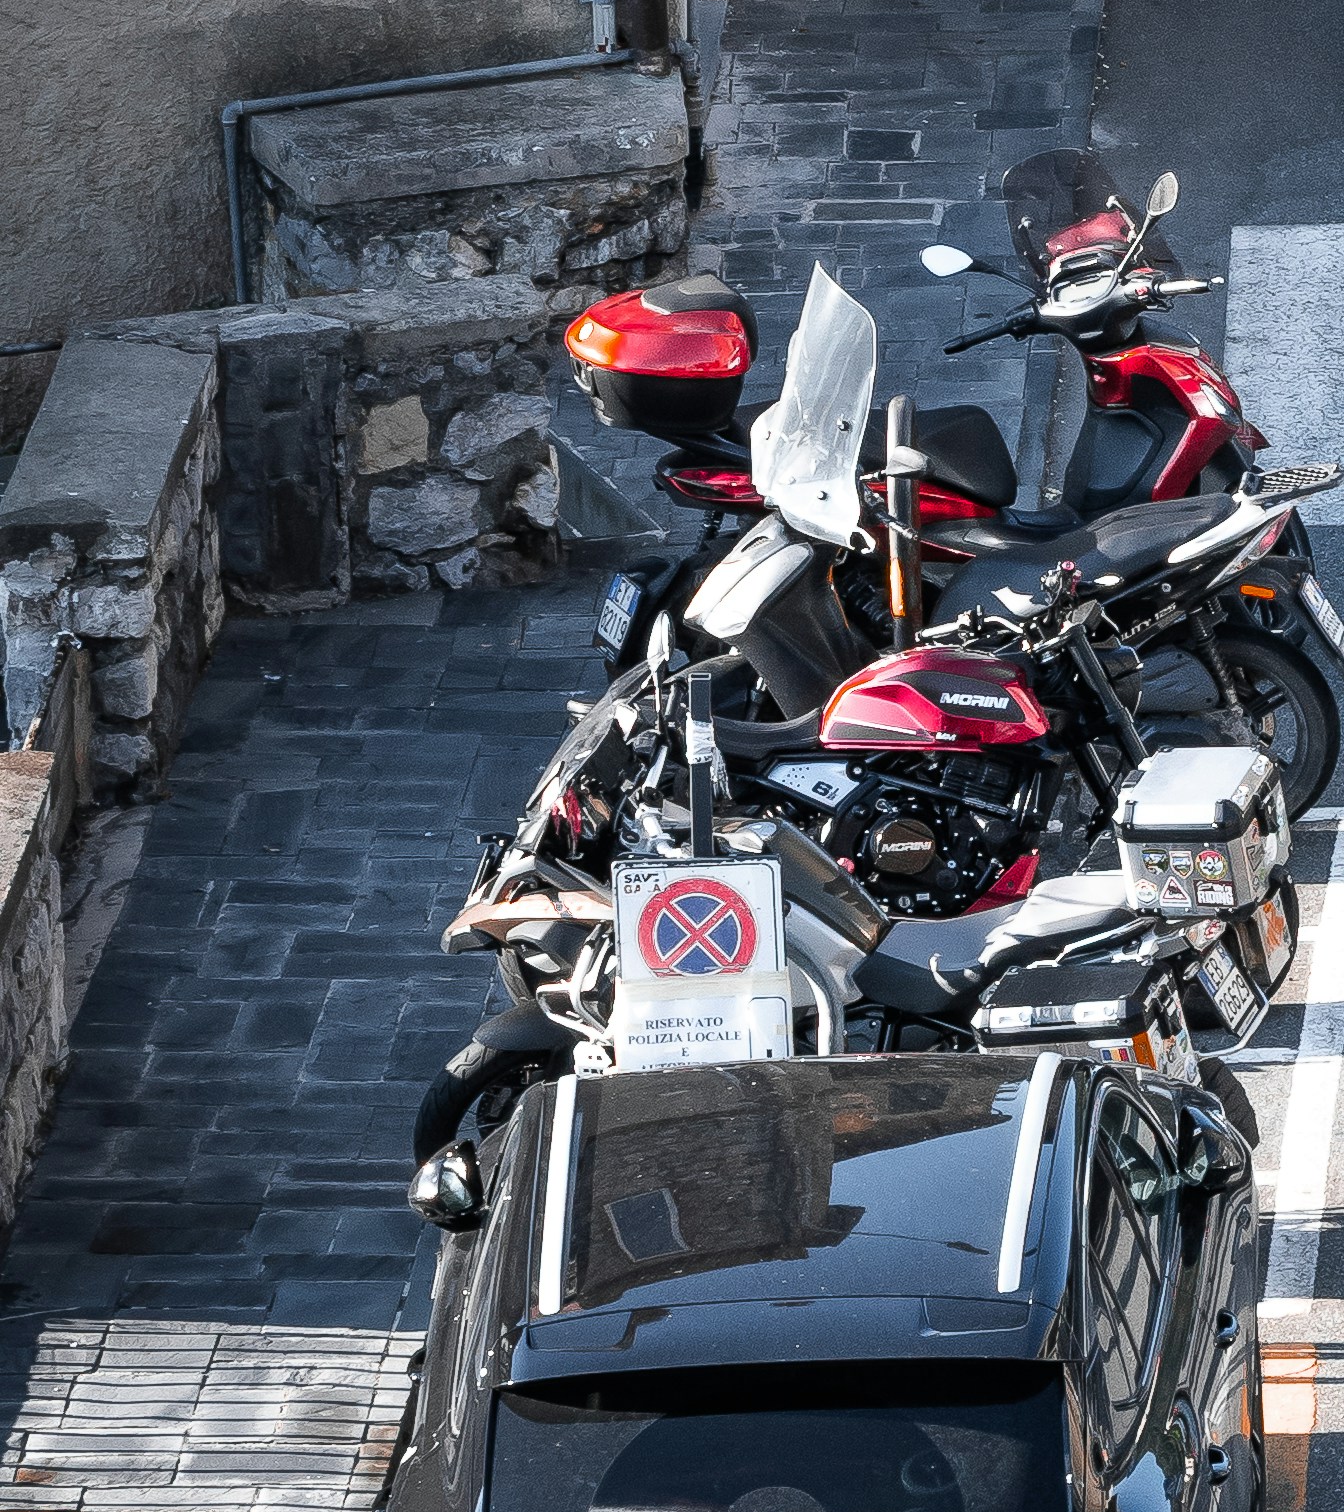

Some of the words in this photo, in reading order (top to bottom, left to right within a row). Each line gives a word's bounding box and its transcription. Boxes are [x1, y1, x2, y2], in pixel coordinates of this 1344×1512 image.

[940, 692, 1010, 710] MORINI
[881, 840, 932, 854] MORINI
[1219, 973, 1250, 1023] 26629
[644, 1016, 724, 1030] RISERVATO
[628, 1032, 682, 1045] POLIZIA
[687, 1030, 742, 1043] LOCALE
[681, 1047, 690, 1057] E
